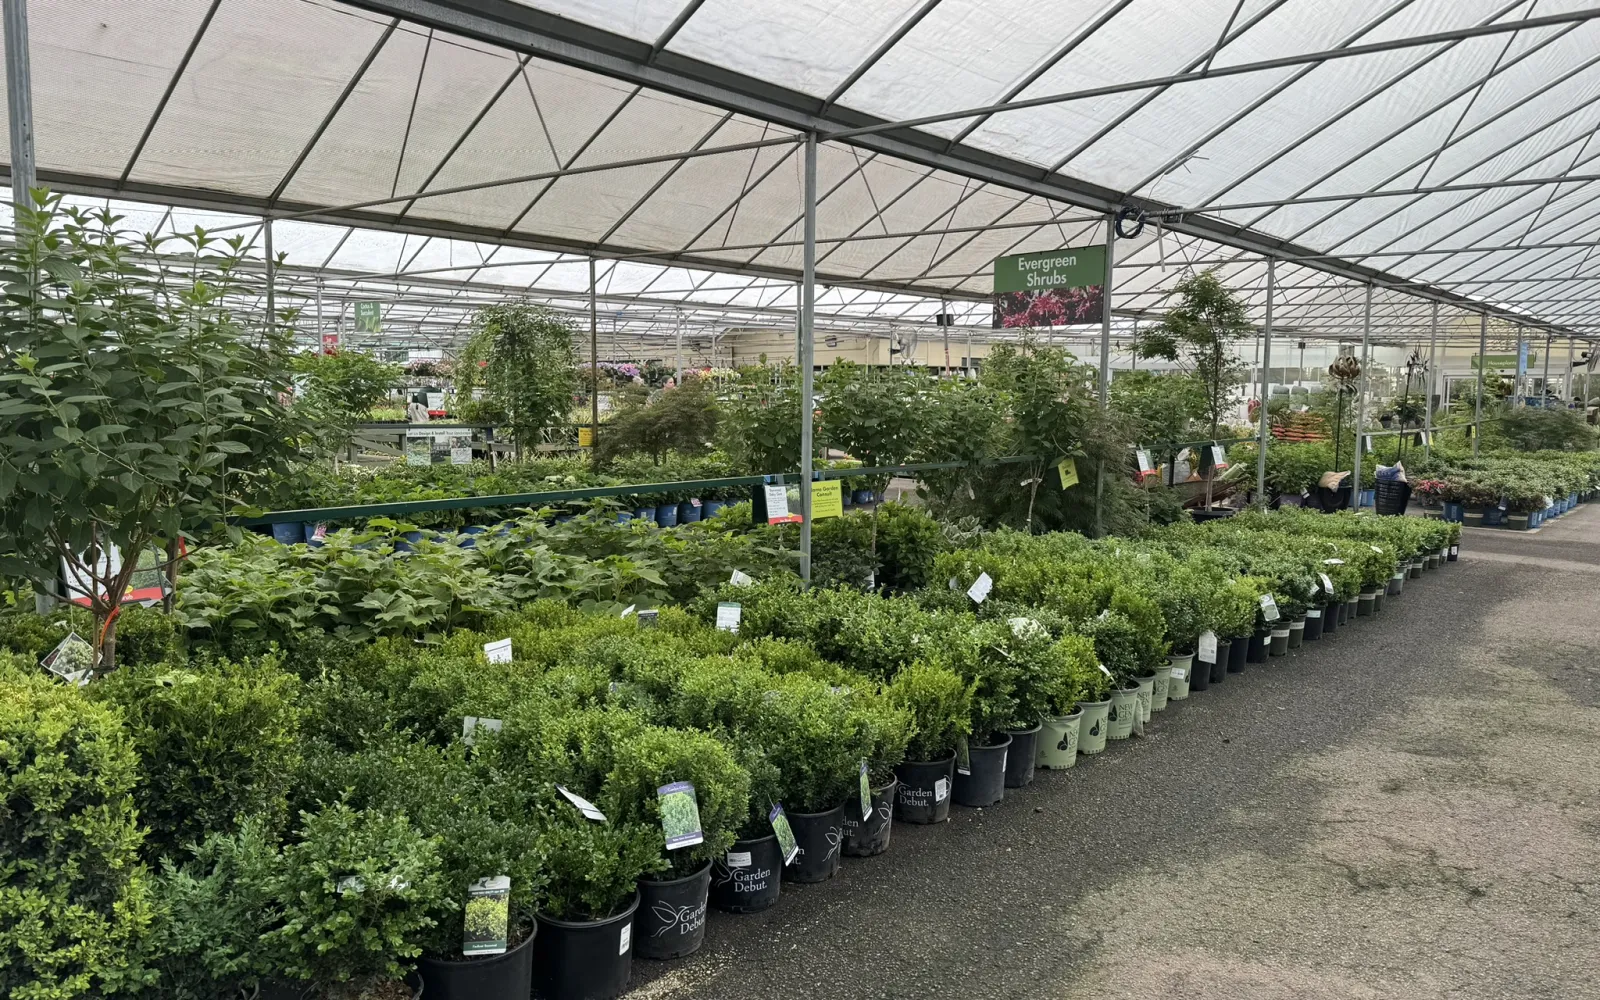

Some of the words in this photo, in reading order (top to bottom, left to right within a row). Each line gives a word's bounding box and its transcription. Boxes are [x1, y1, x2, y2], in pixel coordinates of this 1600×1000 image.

[1018, 256, 1077, 272] Evergreen
[1026, 270, 1067, 287] Shrubs
[1119, 703, 1133, 711] NEW
[1118, 710, 1133, 719] GEN
[899, 786, 933, 797] Garden
[842, 816, 859, 827] den
[733, 868, 771, 882] Garden
